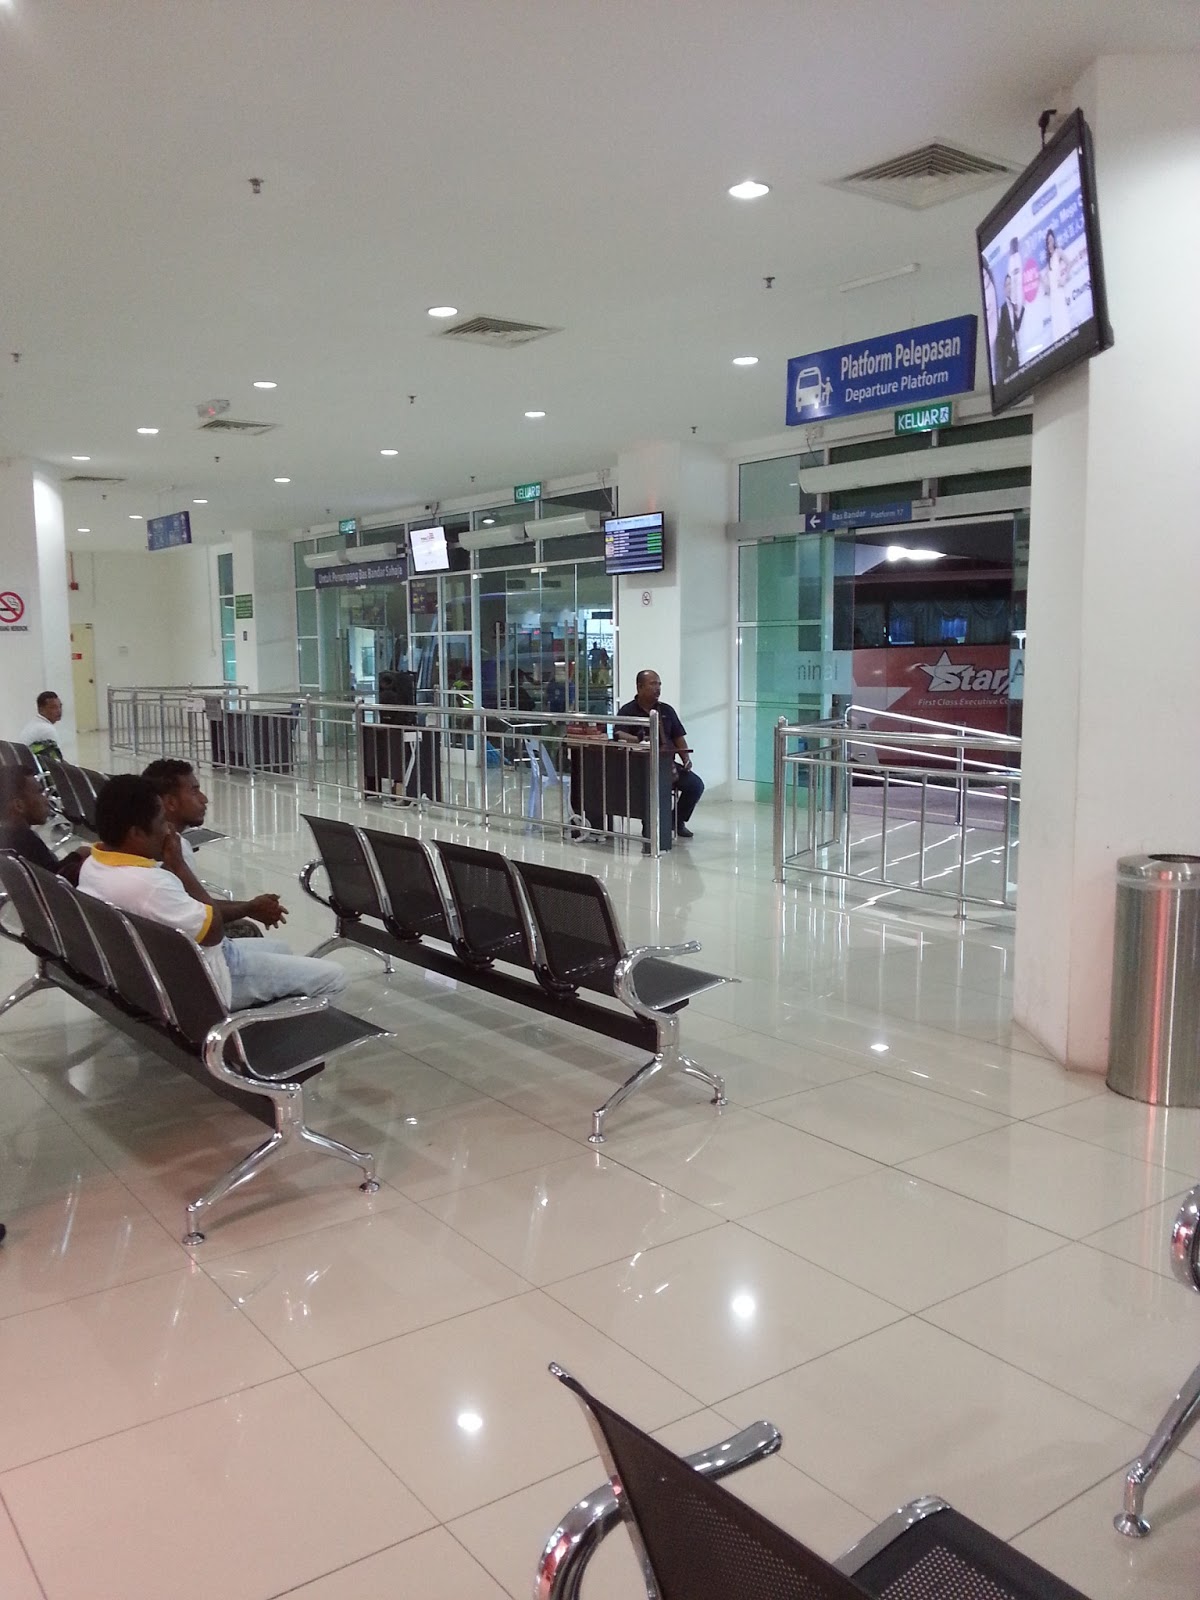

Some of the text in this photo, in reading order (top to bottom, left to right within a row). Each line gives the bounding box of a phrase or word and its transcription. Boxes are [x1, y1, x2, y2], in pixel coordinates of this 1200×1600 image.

[840, 336, 961, 381] Platform Pelepasan
[845, 370, 949, 403] Departure Platform
[898, 408, 939, 431] KELUAR
[918, 698, 937, 707] First
[938, 698, 958, 706] Class
[959, 697, 998, 706] Executive
